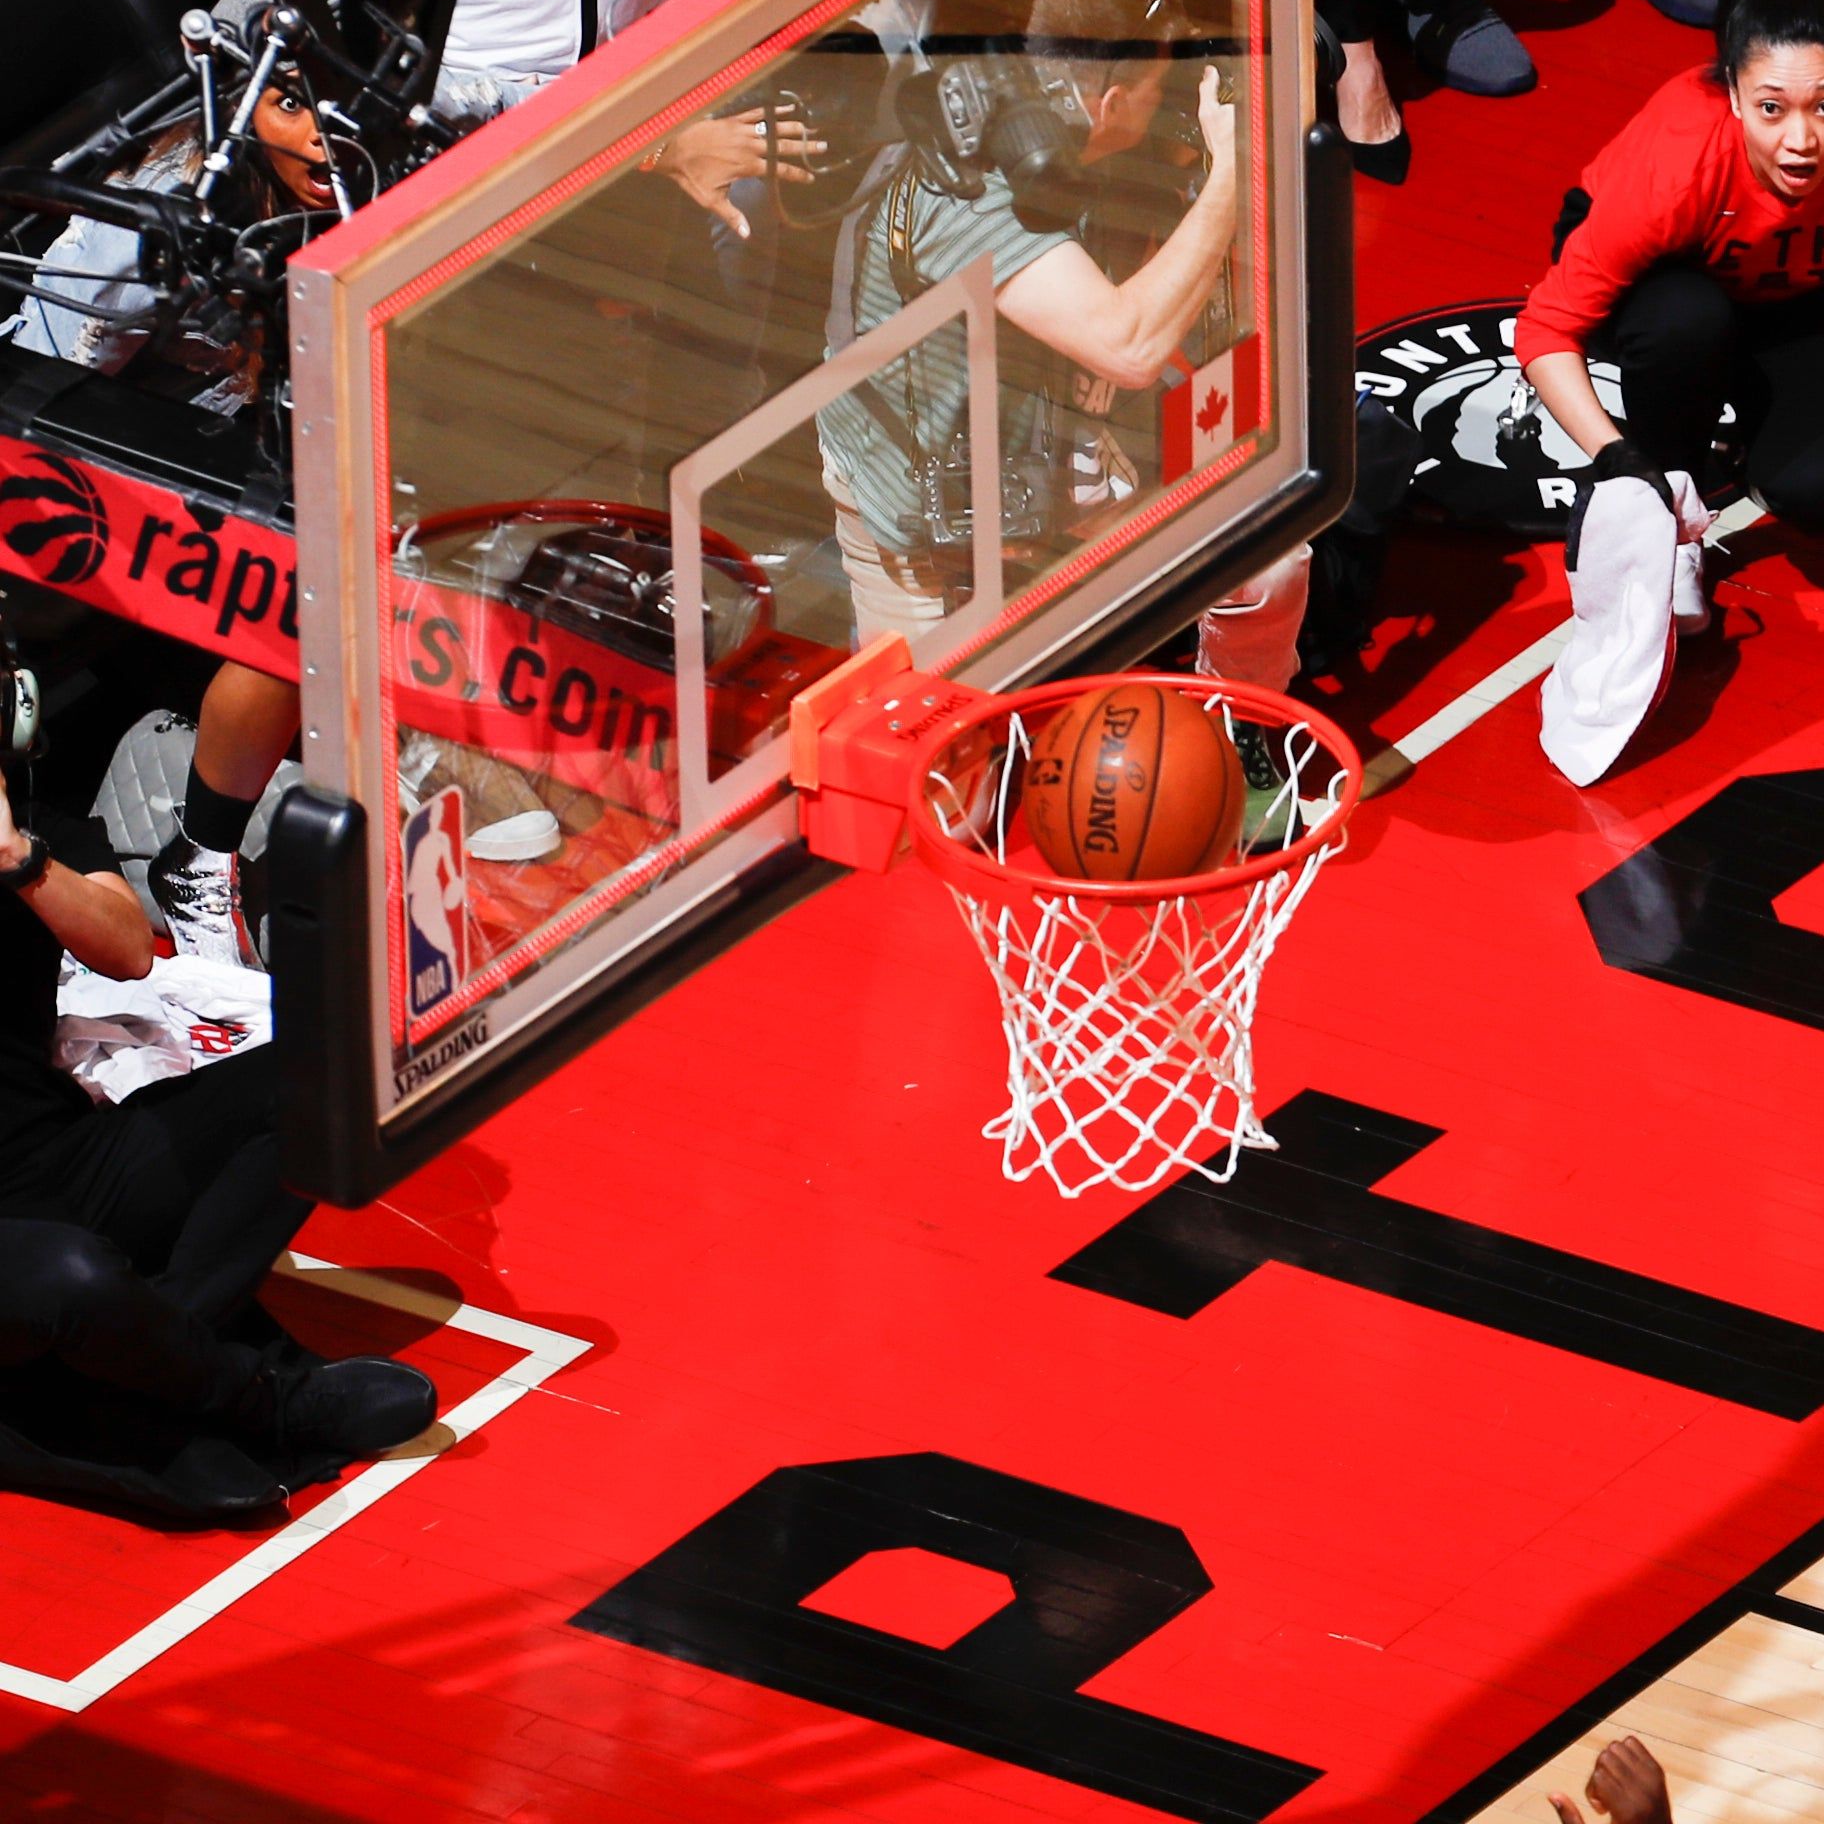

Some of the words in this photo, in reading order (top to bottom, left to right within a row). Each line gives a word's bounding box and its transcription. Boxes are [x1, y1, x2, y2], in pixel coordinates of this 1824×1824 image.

[1084, 703, 1140, 854] SPALDING
[416, 959, 446, 1008] NBA
[393, 1013, 489, 1104] SPALDING
